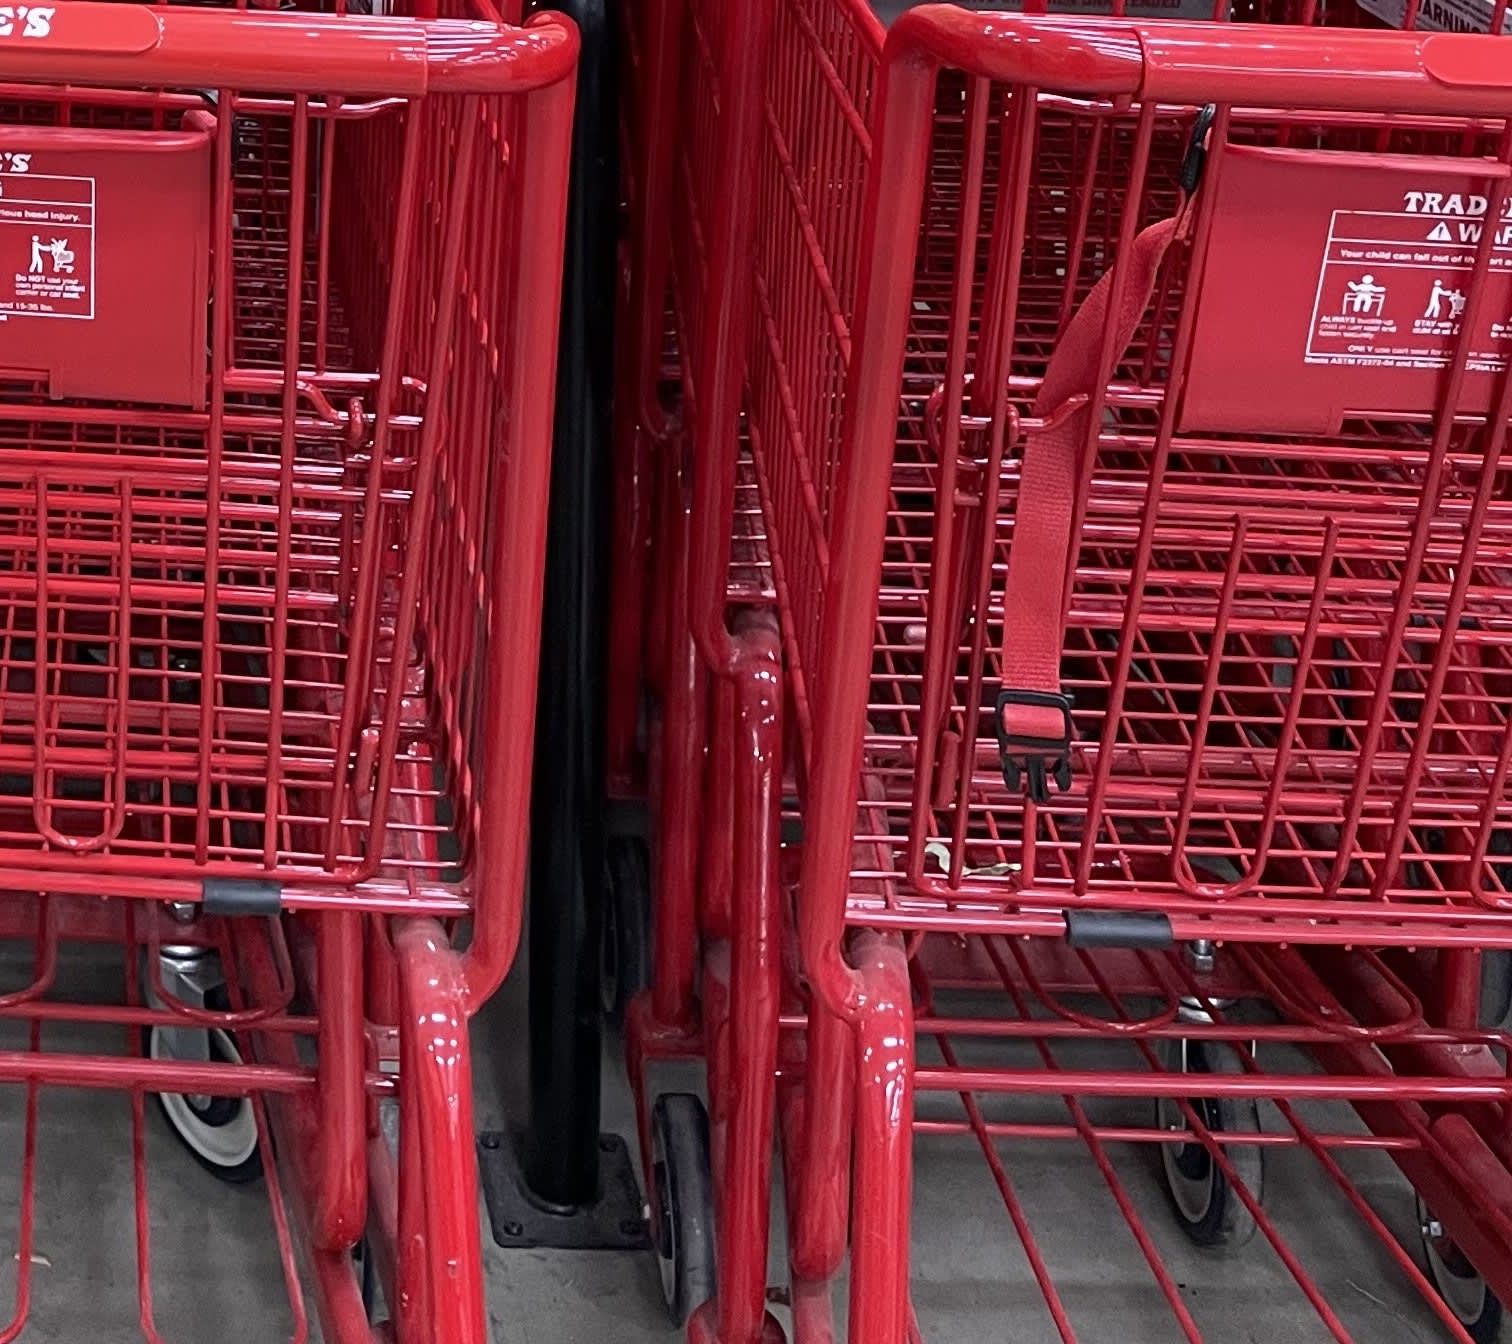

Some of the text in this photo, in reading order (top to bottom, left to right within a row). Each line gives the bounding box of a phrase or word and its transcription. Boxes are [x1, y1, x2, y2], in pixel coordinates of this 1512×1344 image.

[1404, 191, 1512, 216] TRAD
[24, 209, 49, 219] head
[1365, 250, 1391, 260] child
